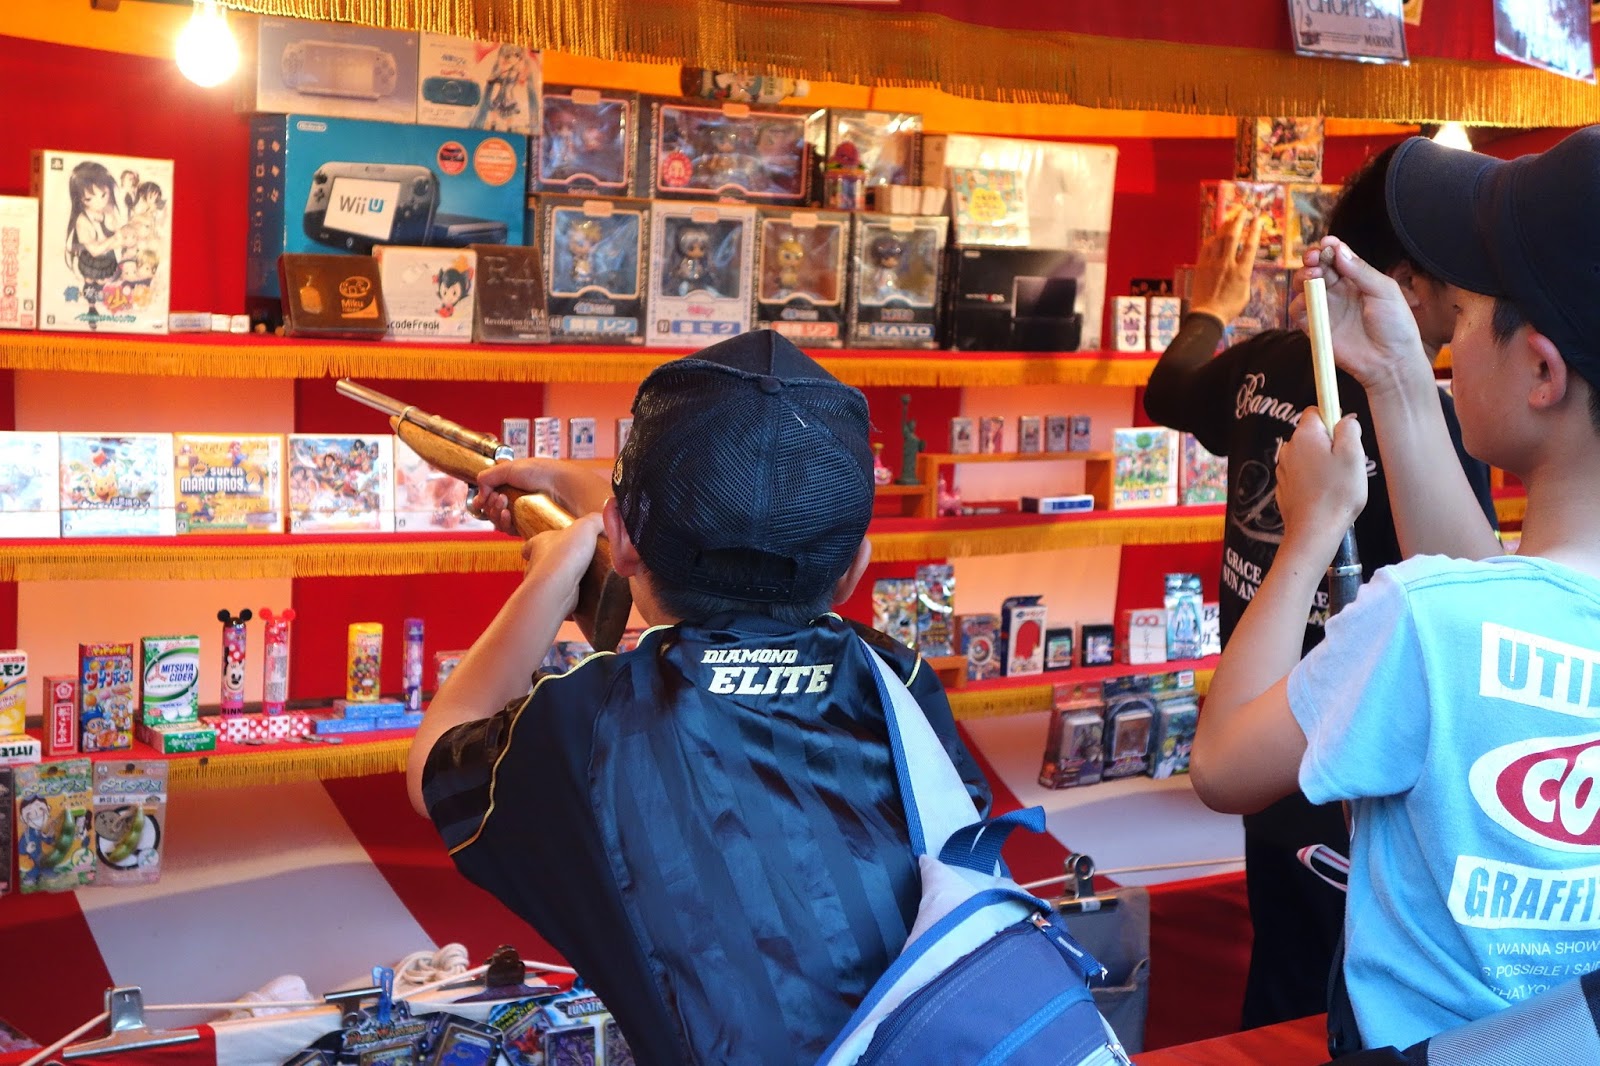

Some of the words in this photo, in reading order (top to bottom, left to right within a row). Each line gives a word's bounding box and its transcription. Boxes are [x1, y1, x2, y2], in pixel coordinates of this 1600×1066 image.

[340, 195, 366, 214] Wii
[341, 299, 363, 308] Miku
[874, 325, 931, 337] KAITO
[180, 477, 215, 493] MARIO
[1226, 547, 1262, 585] GRACE
[1223, 564, 1240, 592] SUN
[701, 649, 798, 664] DIAMOND
[160, 663, 194, 674] MITSUYA
[1497, 637, 1600, 708] UTI
[169, 673, 193, 682] CIDER
[708, 664, 833, 695] ELITE
[1464, 867, 1600, 921] GRAFFI
[1488, 943, 1493, 955] I
[1496, 942, 1552, 955] WANNA
[1555, 940, 1600, 954] SHOW
[1496, 964, 1561, 978] POSSIBLE
[1527, 984, 1551, 995] YO
